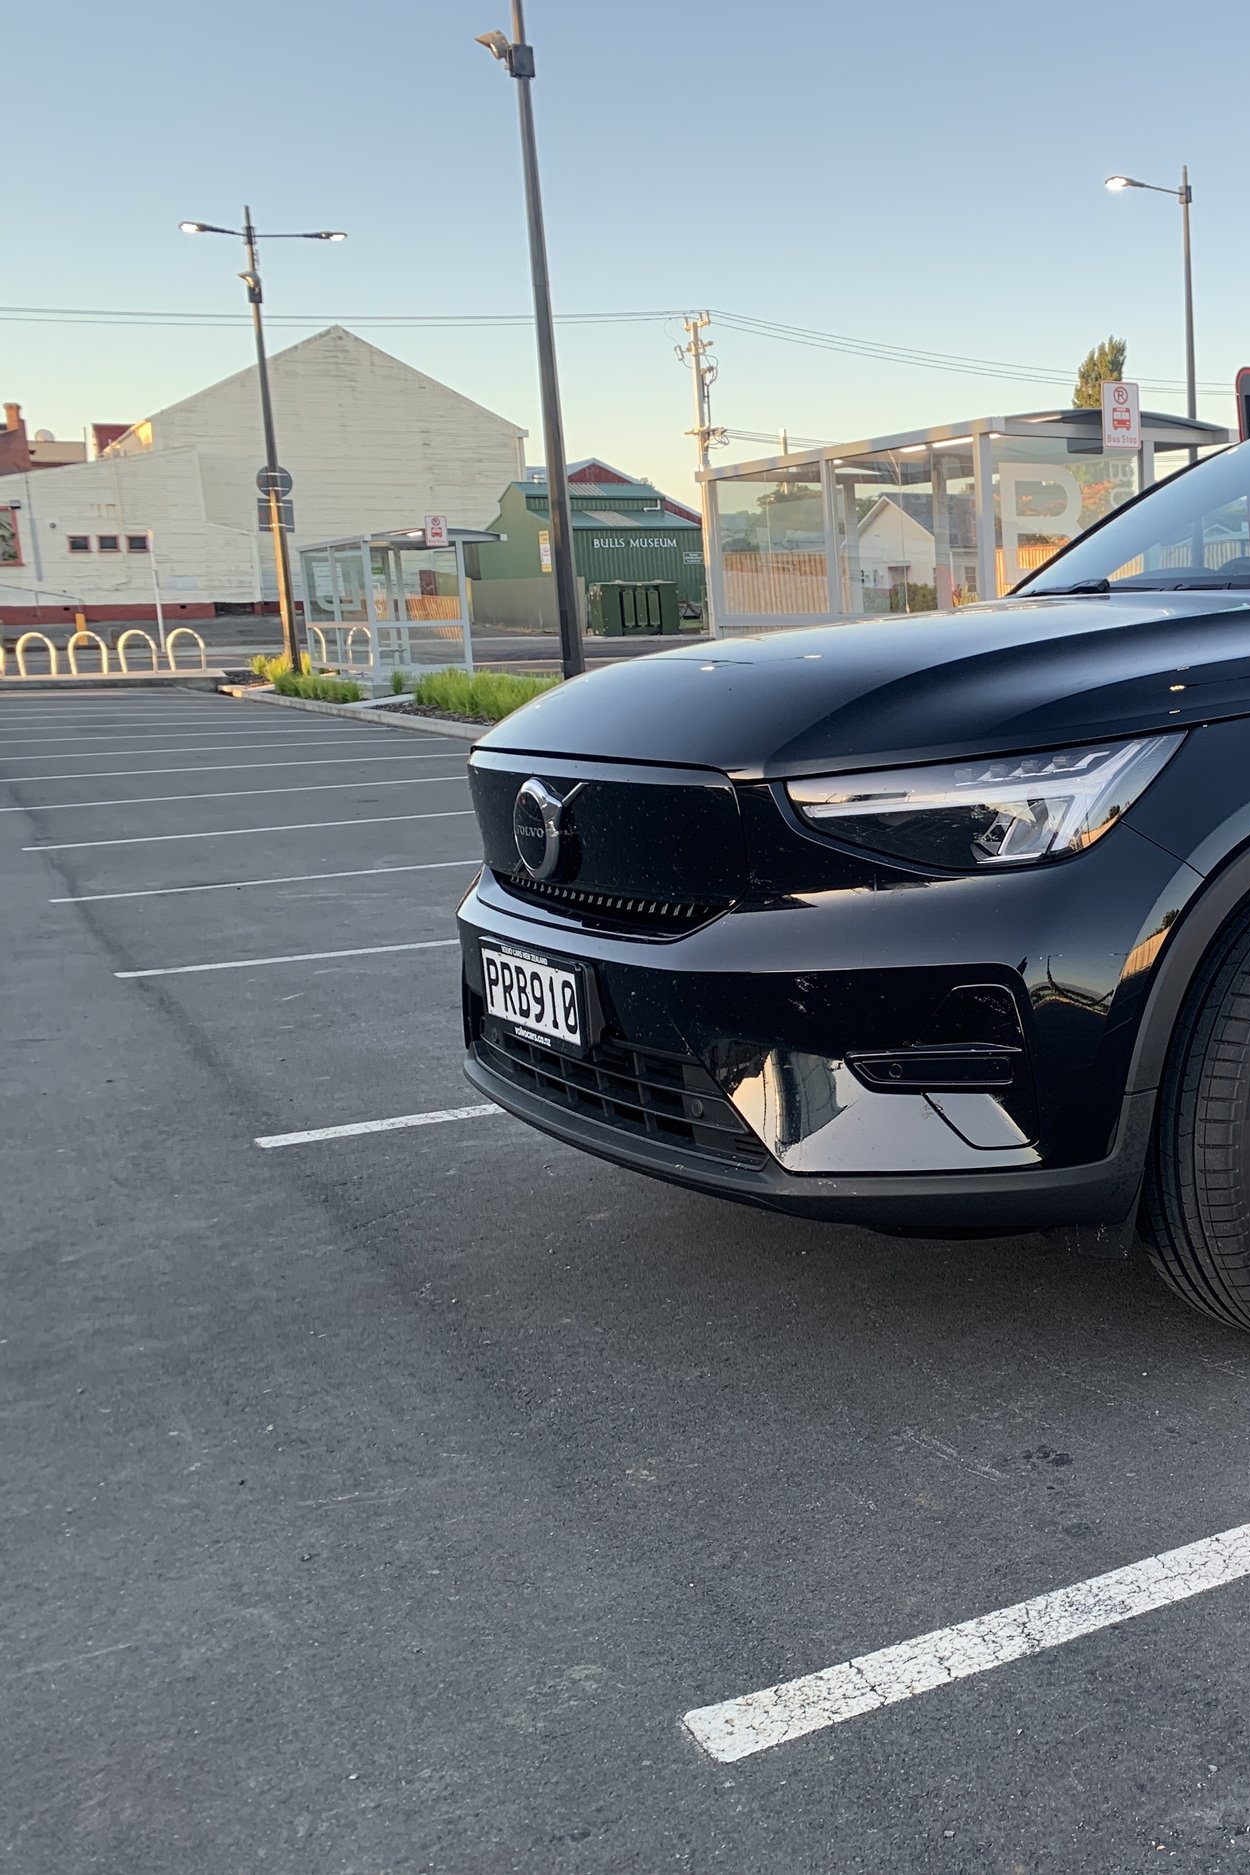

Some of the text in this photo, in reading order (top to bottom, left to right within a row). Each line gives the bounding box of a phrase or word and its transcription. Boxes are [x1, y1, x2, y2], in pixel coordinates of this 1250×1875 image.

[1107, 433, 1138, 445] Bus Stop
[593, 537, 678, 549] BULLS MUSEUM
[516, 825, 545, 838] VOLVO
[486, 957, 578, 1035] PRB910
